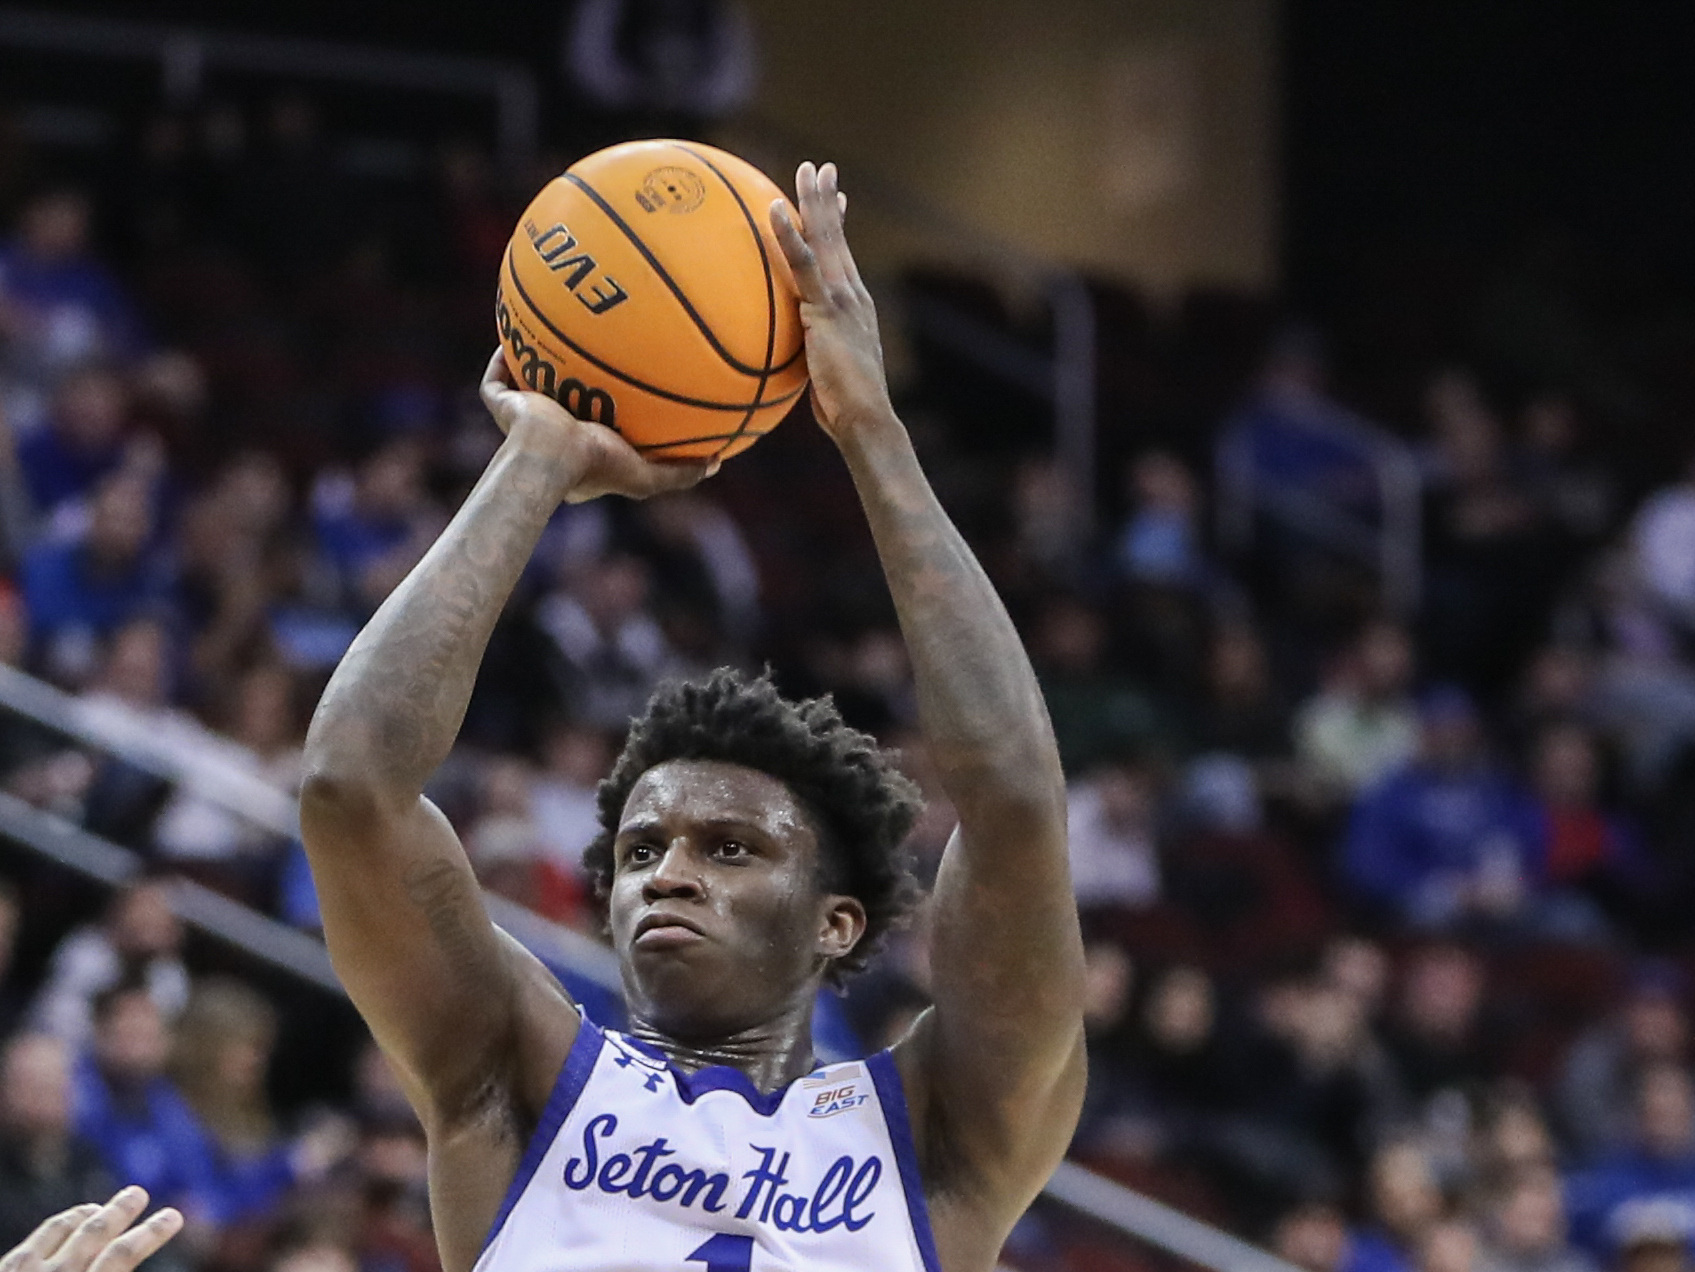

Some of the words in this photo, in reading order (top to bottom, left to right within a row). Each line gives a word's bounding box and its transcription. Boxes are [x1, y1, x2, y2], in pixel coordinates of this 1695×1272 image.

[533, 222, 628, 316] EVO
[809, 1094, 869, 1114] EAST
[815, 1085, 856, 1106] BIG
[563, 1113, 730, 1213] Seton
[735, 1143, 883, 1234] Hall
